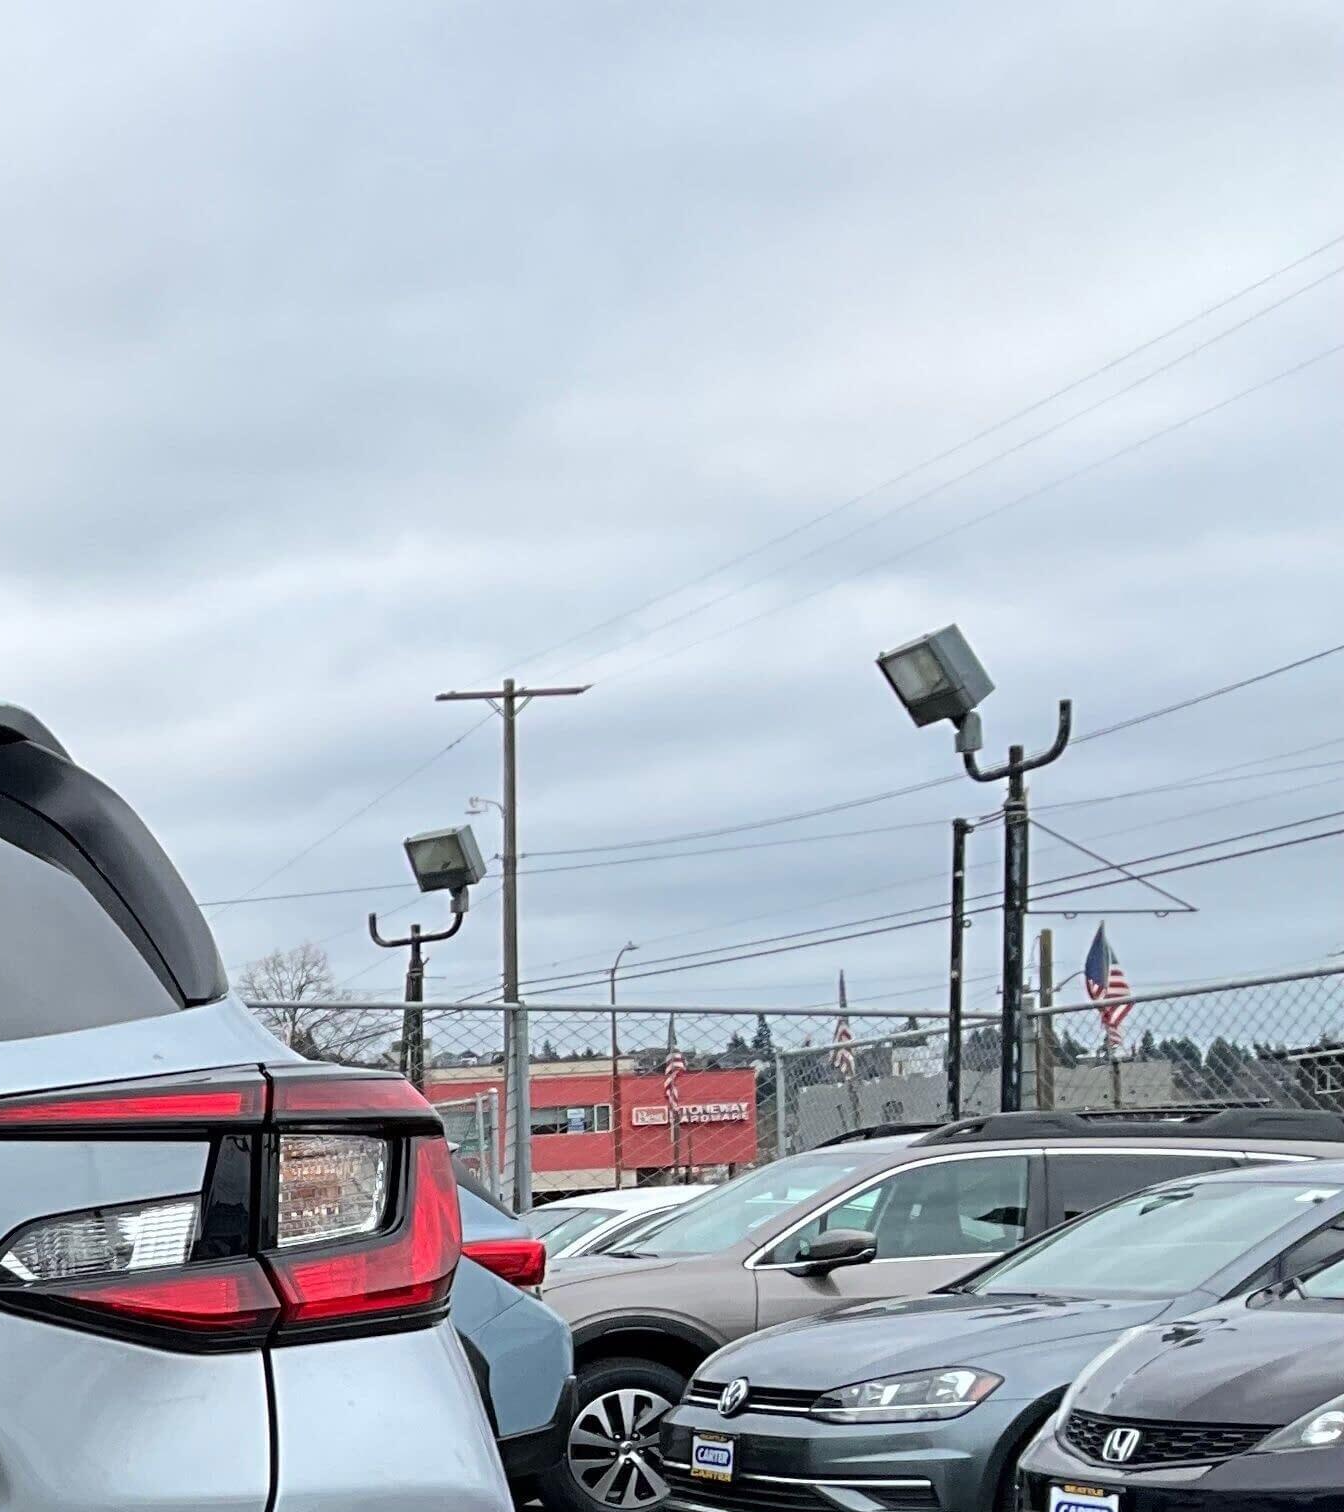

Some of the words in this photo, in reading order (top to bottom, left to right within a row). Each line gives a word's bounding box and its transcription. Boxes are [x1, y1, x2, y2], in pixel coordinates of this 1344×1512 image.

[674, 1102, 749, 1116] TONEWAY
[674, 1112, 749, 1124] ARDWARE
[697, 1447, 728, 1465] CARTER
